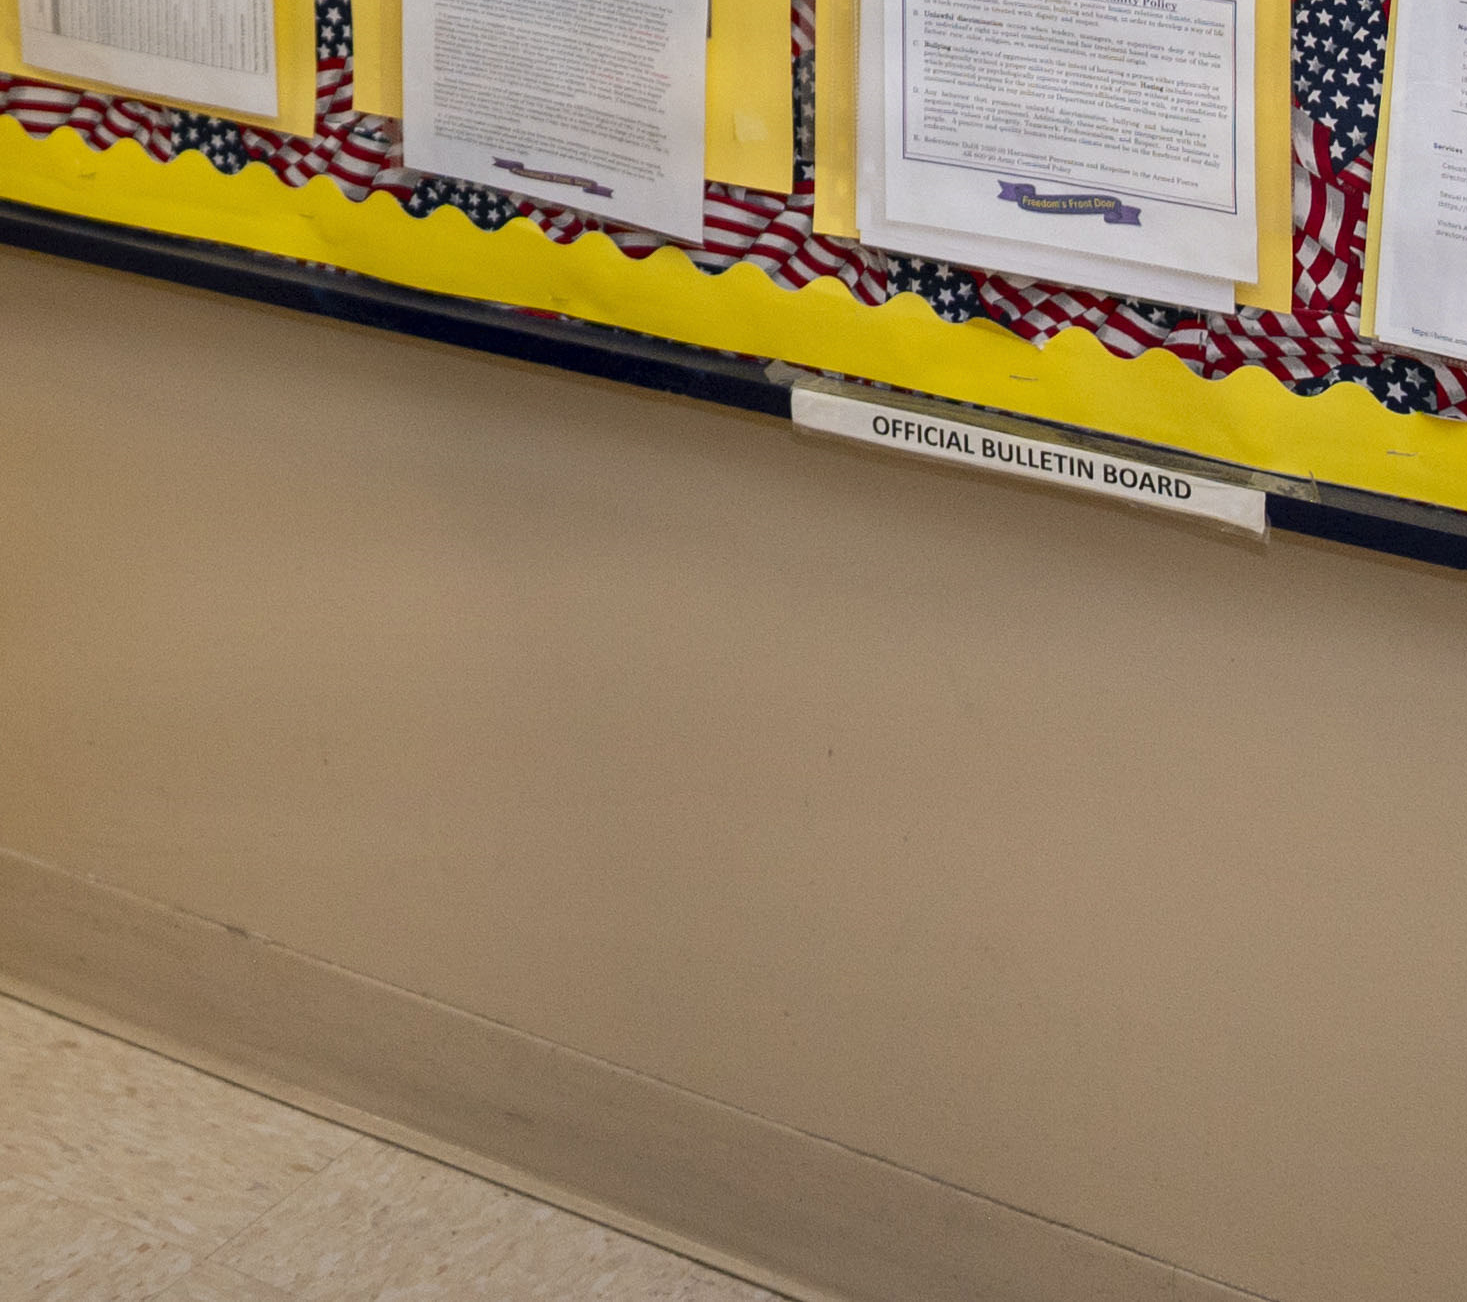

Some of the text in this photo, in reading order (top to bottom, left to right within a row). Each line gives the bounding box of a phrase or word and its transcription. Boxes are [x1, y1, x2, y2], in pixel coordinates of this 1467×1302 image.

[872, 415, 1193, 500] OFFICIAL BULLETIN BOARD
